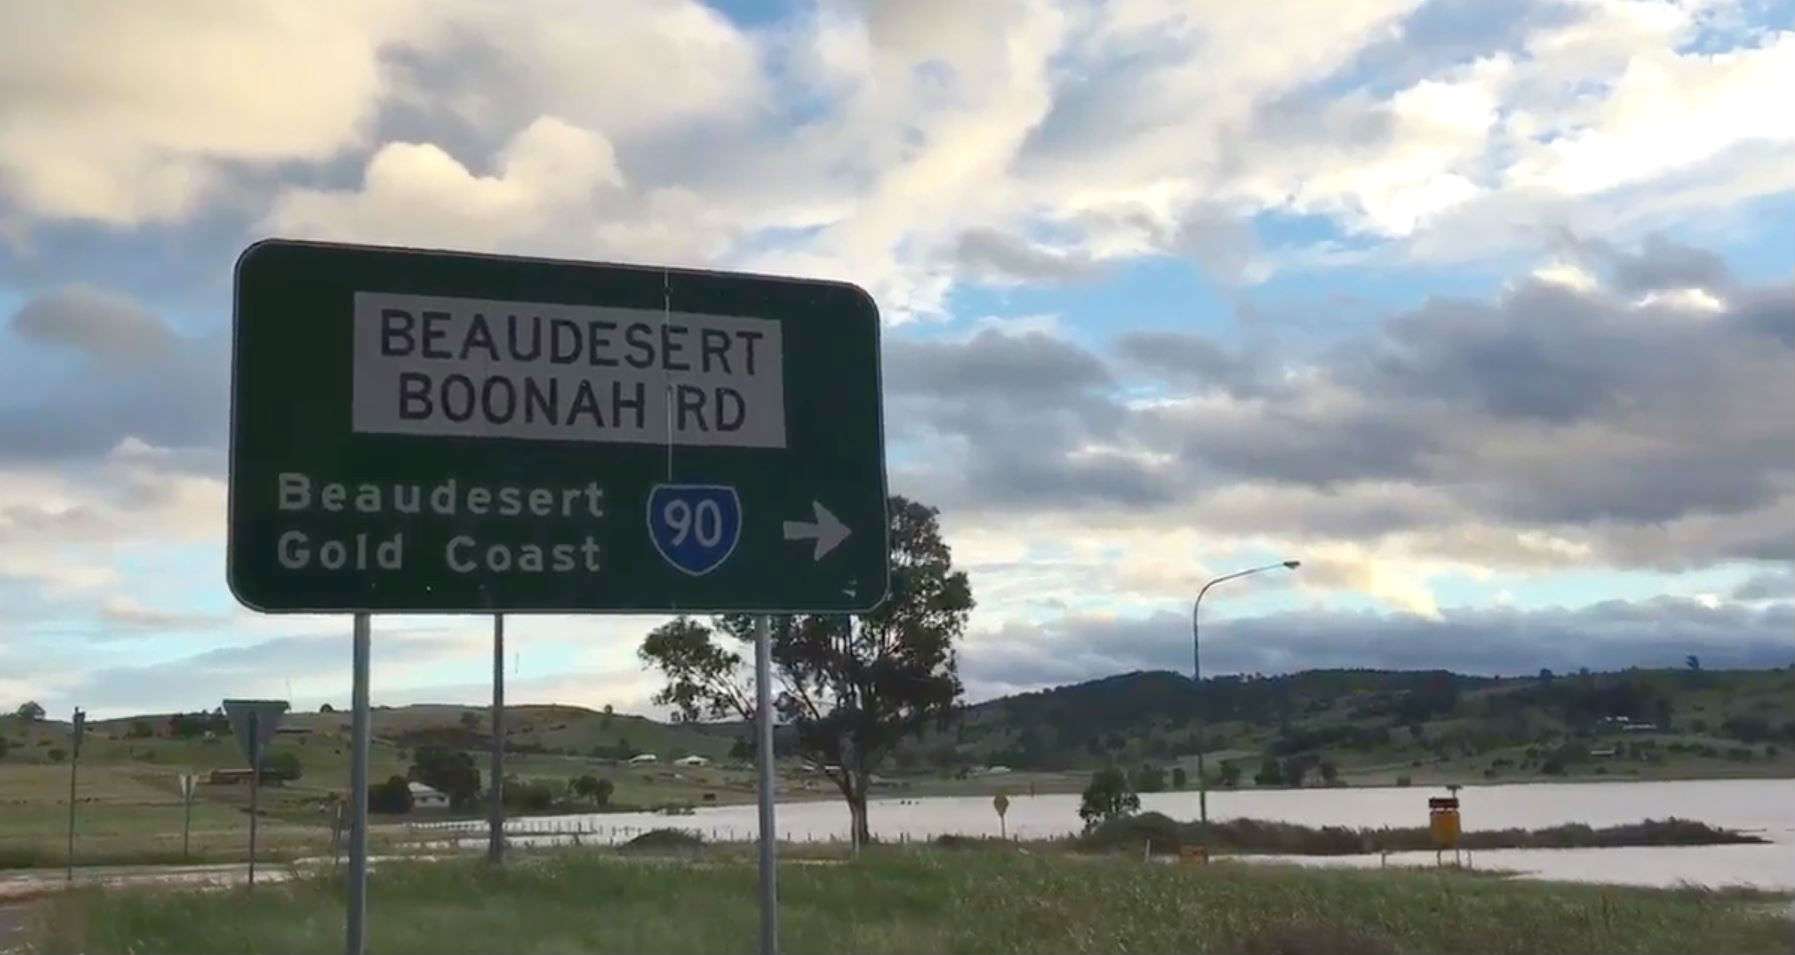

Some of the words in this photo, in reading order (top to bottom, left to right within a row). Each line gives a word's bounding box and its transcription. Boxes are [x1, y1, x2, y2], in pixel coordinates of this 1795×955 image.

[380, 309, 763, 375] BEAUDESERT
[399, 372, 646, 430] BOONAH
[677, 384, 746, 432] RD
[278, 472, 604, 518] Beaudesert
[663, 498, 723, 548] 90
[277, 531, 403, 571] Gold
[446, 535, 602, 573] Coast
